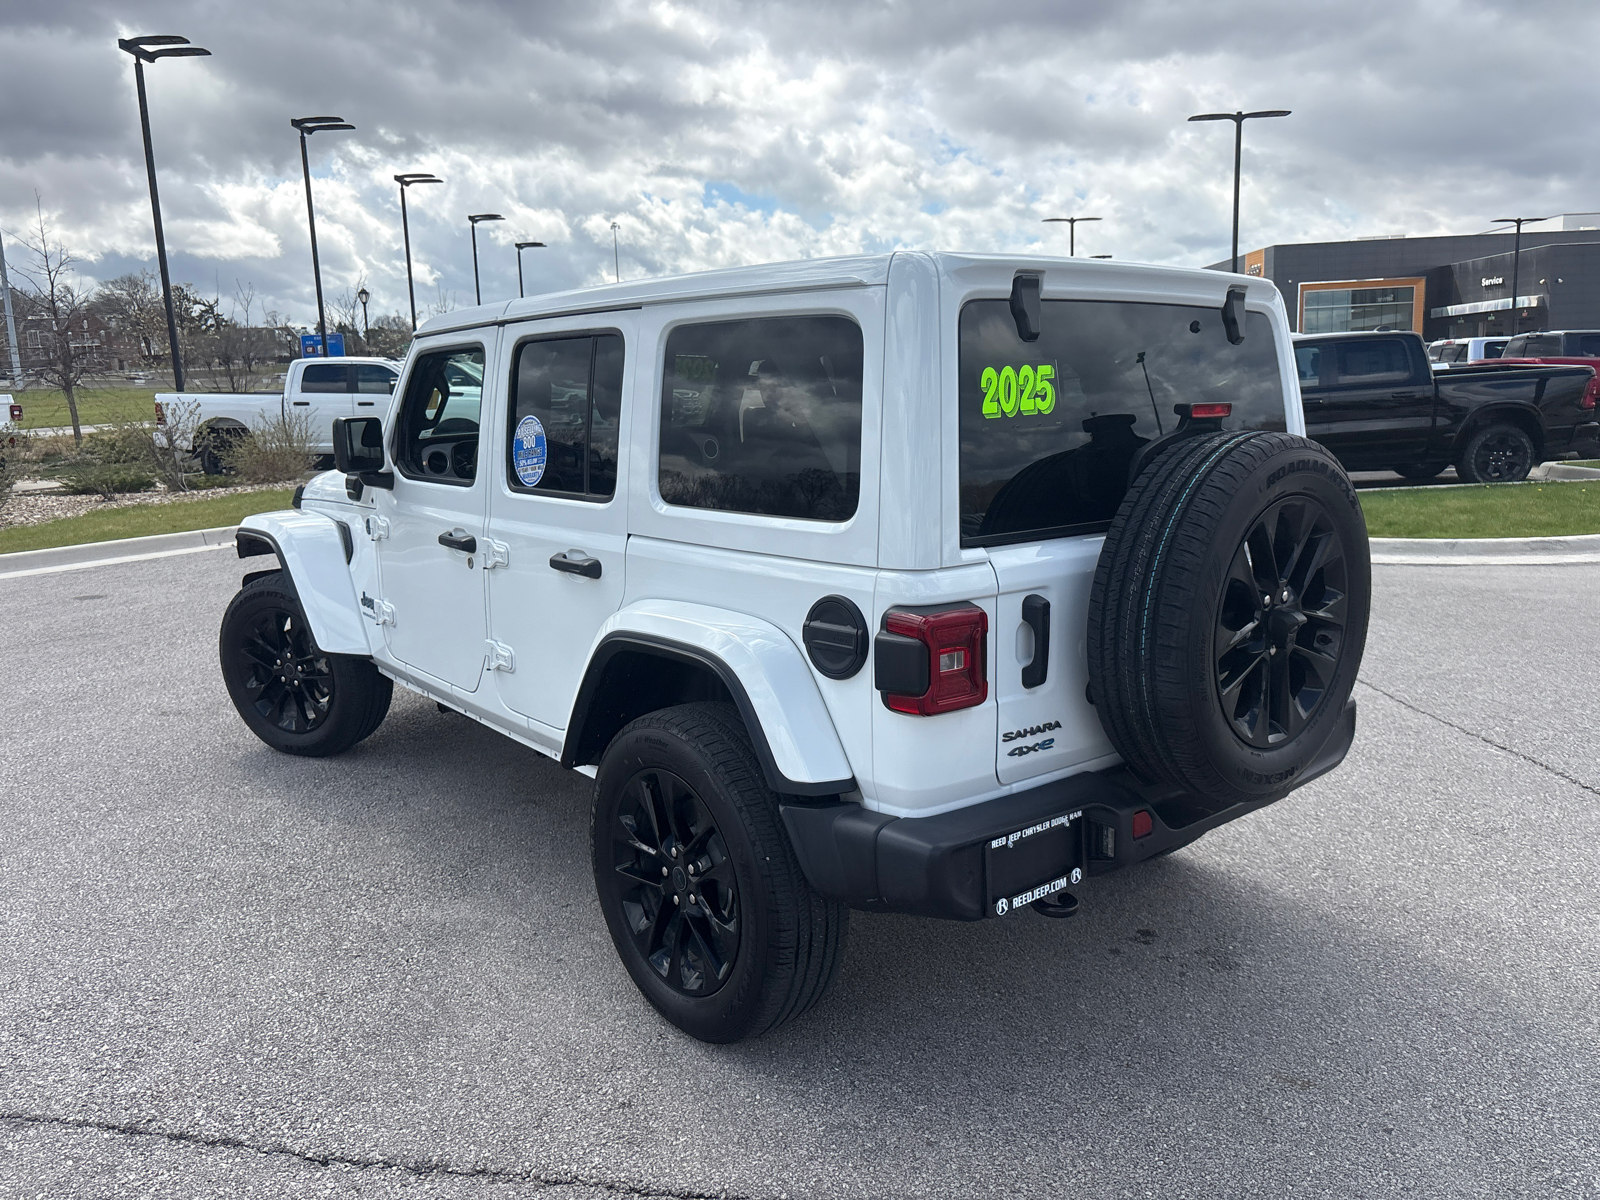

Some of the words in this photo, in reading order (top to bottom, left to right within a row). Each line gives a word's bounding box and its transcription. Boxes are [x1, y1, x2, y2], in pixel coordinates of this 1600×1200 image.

[1481, 276, 1503, 287] Service
[981, 364, 1056, 419] 2025
[1002, 720, 1062, 742] SAHARA
[991, 836, 1007, 849] REED
[1009, 831, 1021, 842] JEEP
[1022, 820, 1051, 838] CHRYSLER
[1051, 814, 1069, 828] DODGE
[1069, 810, 1082, 820] RAM
[1012, 876, 1067, 909] REEDJEEP.COM
